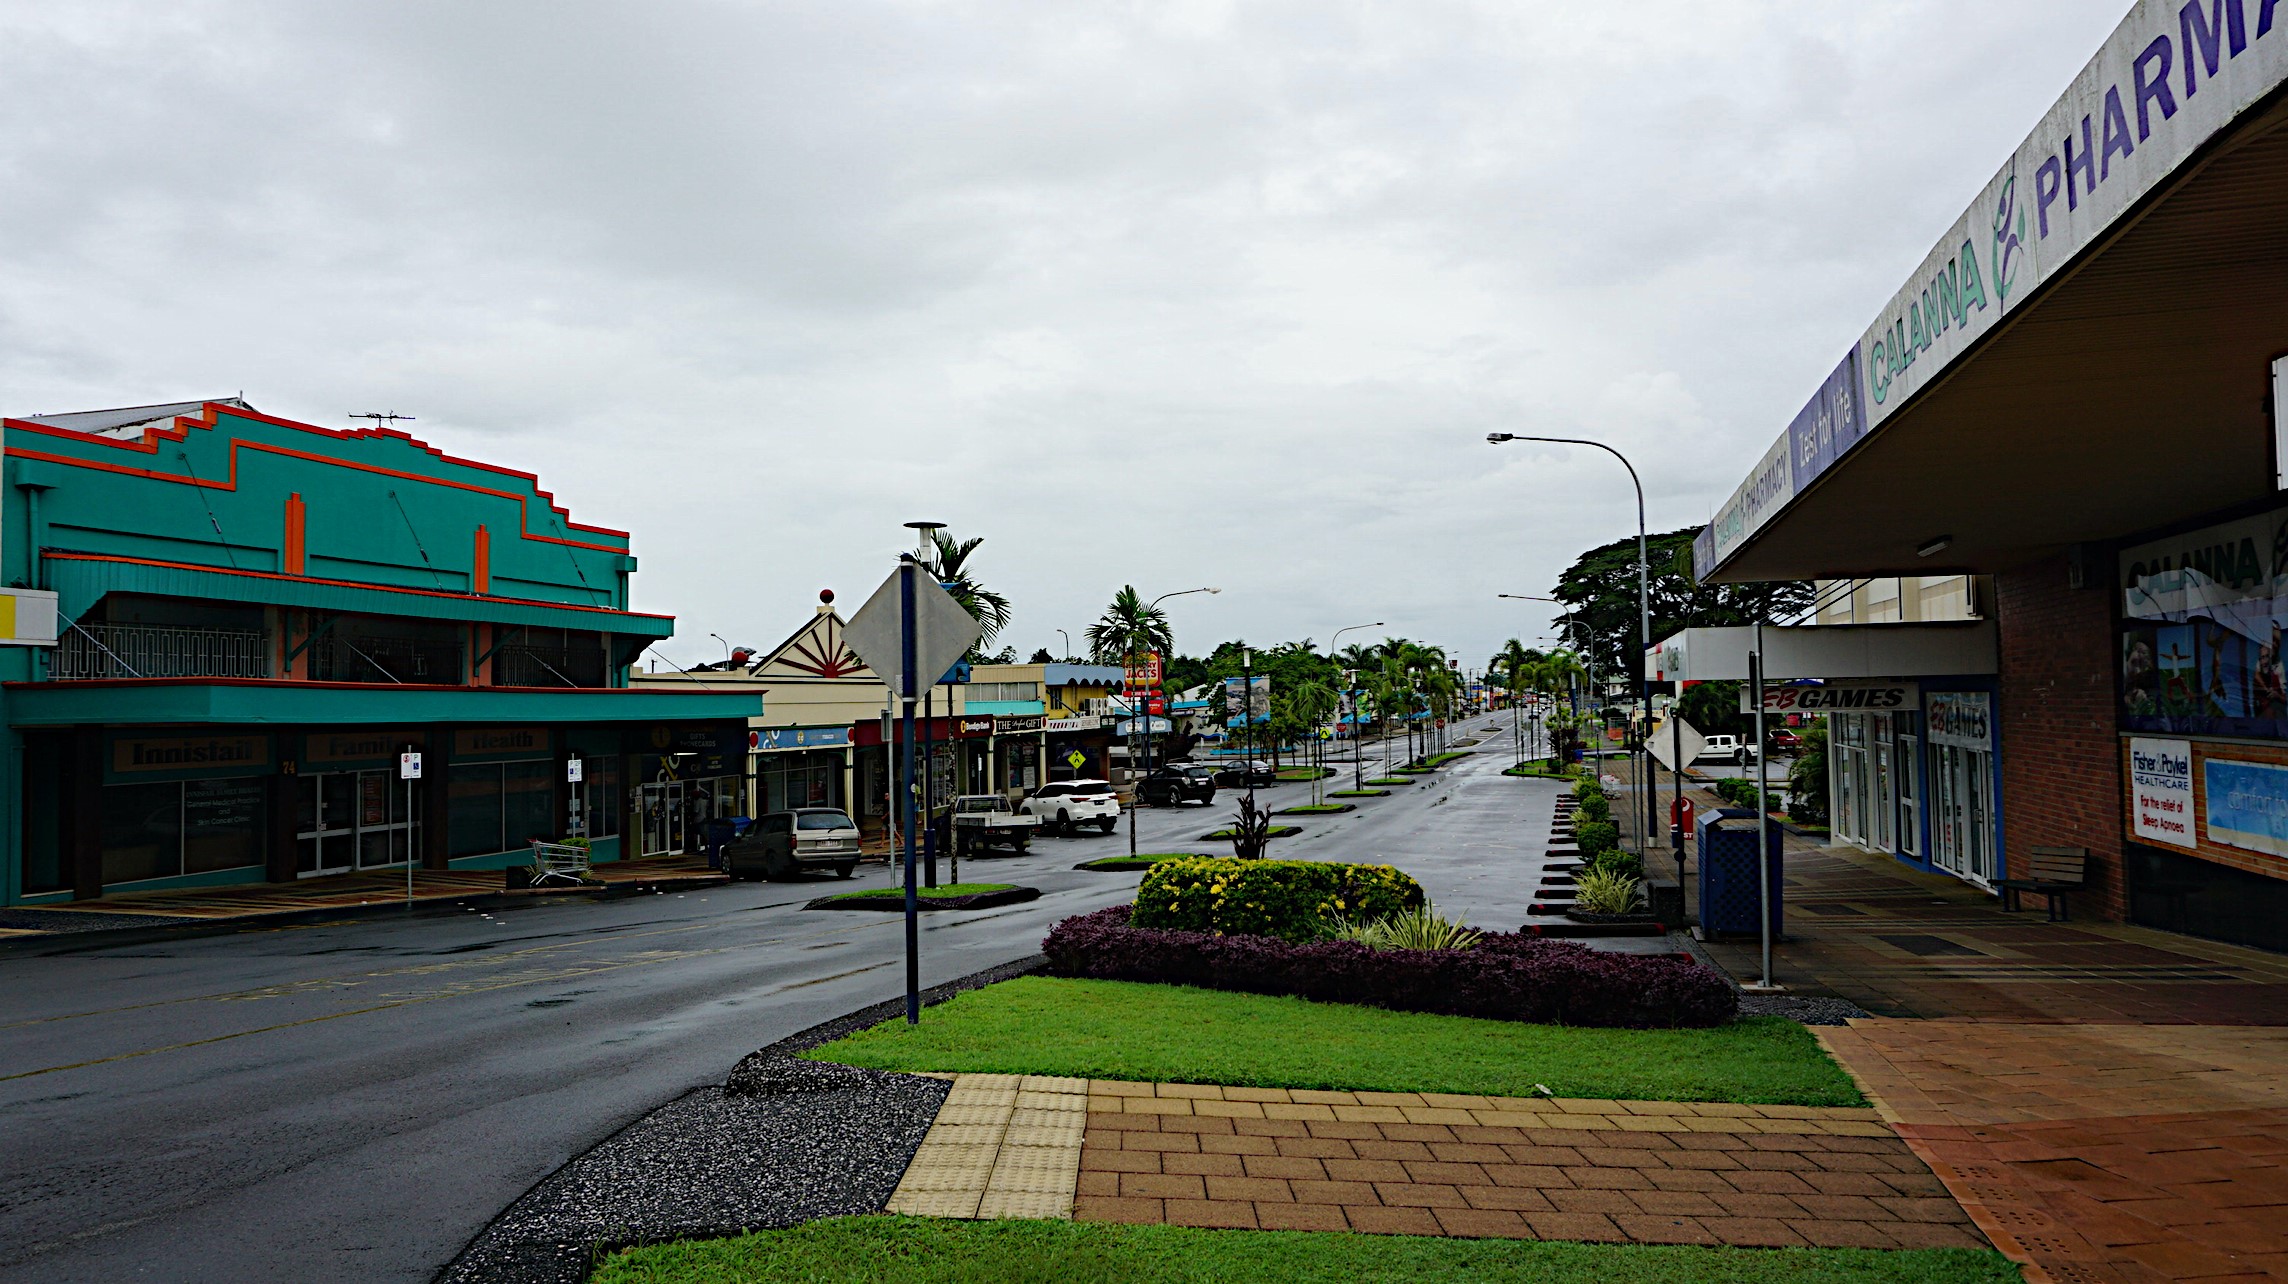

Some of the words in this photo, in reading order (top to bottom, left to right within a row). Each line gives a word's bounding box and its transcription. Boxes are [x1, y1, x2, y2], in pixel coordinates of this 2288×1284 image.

[1871, 238, 1987, 405] CALANNA
[1799, 421, 1818, 468] Zest
[1818, 411, 1832, 449] for
[1833, 387, 1851, 434] life
[1745, 451, 1787, 521] PHARMACY
[2127, 537, 2264, 605] CALANNA
[1763, 688, 1799, 709] EB
[1798, 688, 1905, 708] GAMES
[998, 720, 1011, 730] THE
[1025, 718, 1041, 728] GIFT
[1931, 701, 1946, 731] EB
[1946, 704, 1987, 739] GAMES
[330, 735, 394, 756] Famil
[473, 731, 534, 749] Health
[133, 740, 252, 765] Innisfail
[282, 760, 296, 775] 74
[2133, 751, 2156, 771] Fisher
[2161, 753, 2188, 777] Paykel
[2134, 775, 2189, 791] HEALTHCARE
[2140, 794, 2149, 807] For
[2150, 796, 2159, 809] the
[2161, 798, 2176, 811] relief
[2177, 800, 2183, 813] of
[211, 816, 233, 825] Cancer
[2142, 813, 2158, 829] Sleep
[2160, 816, 2184, 834] Apnoea
